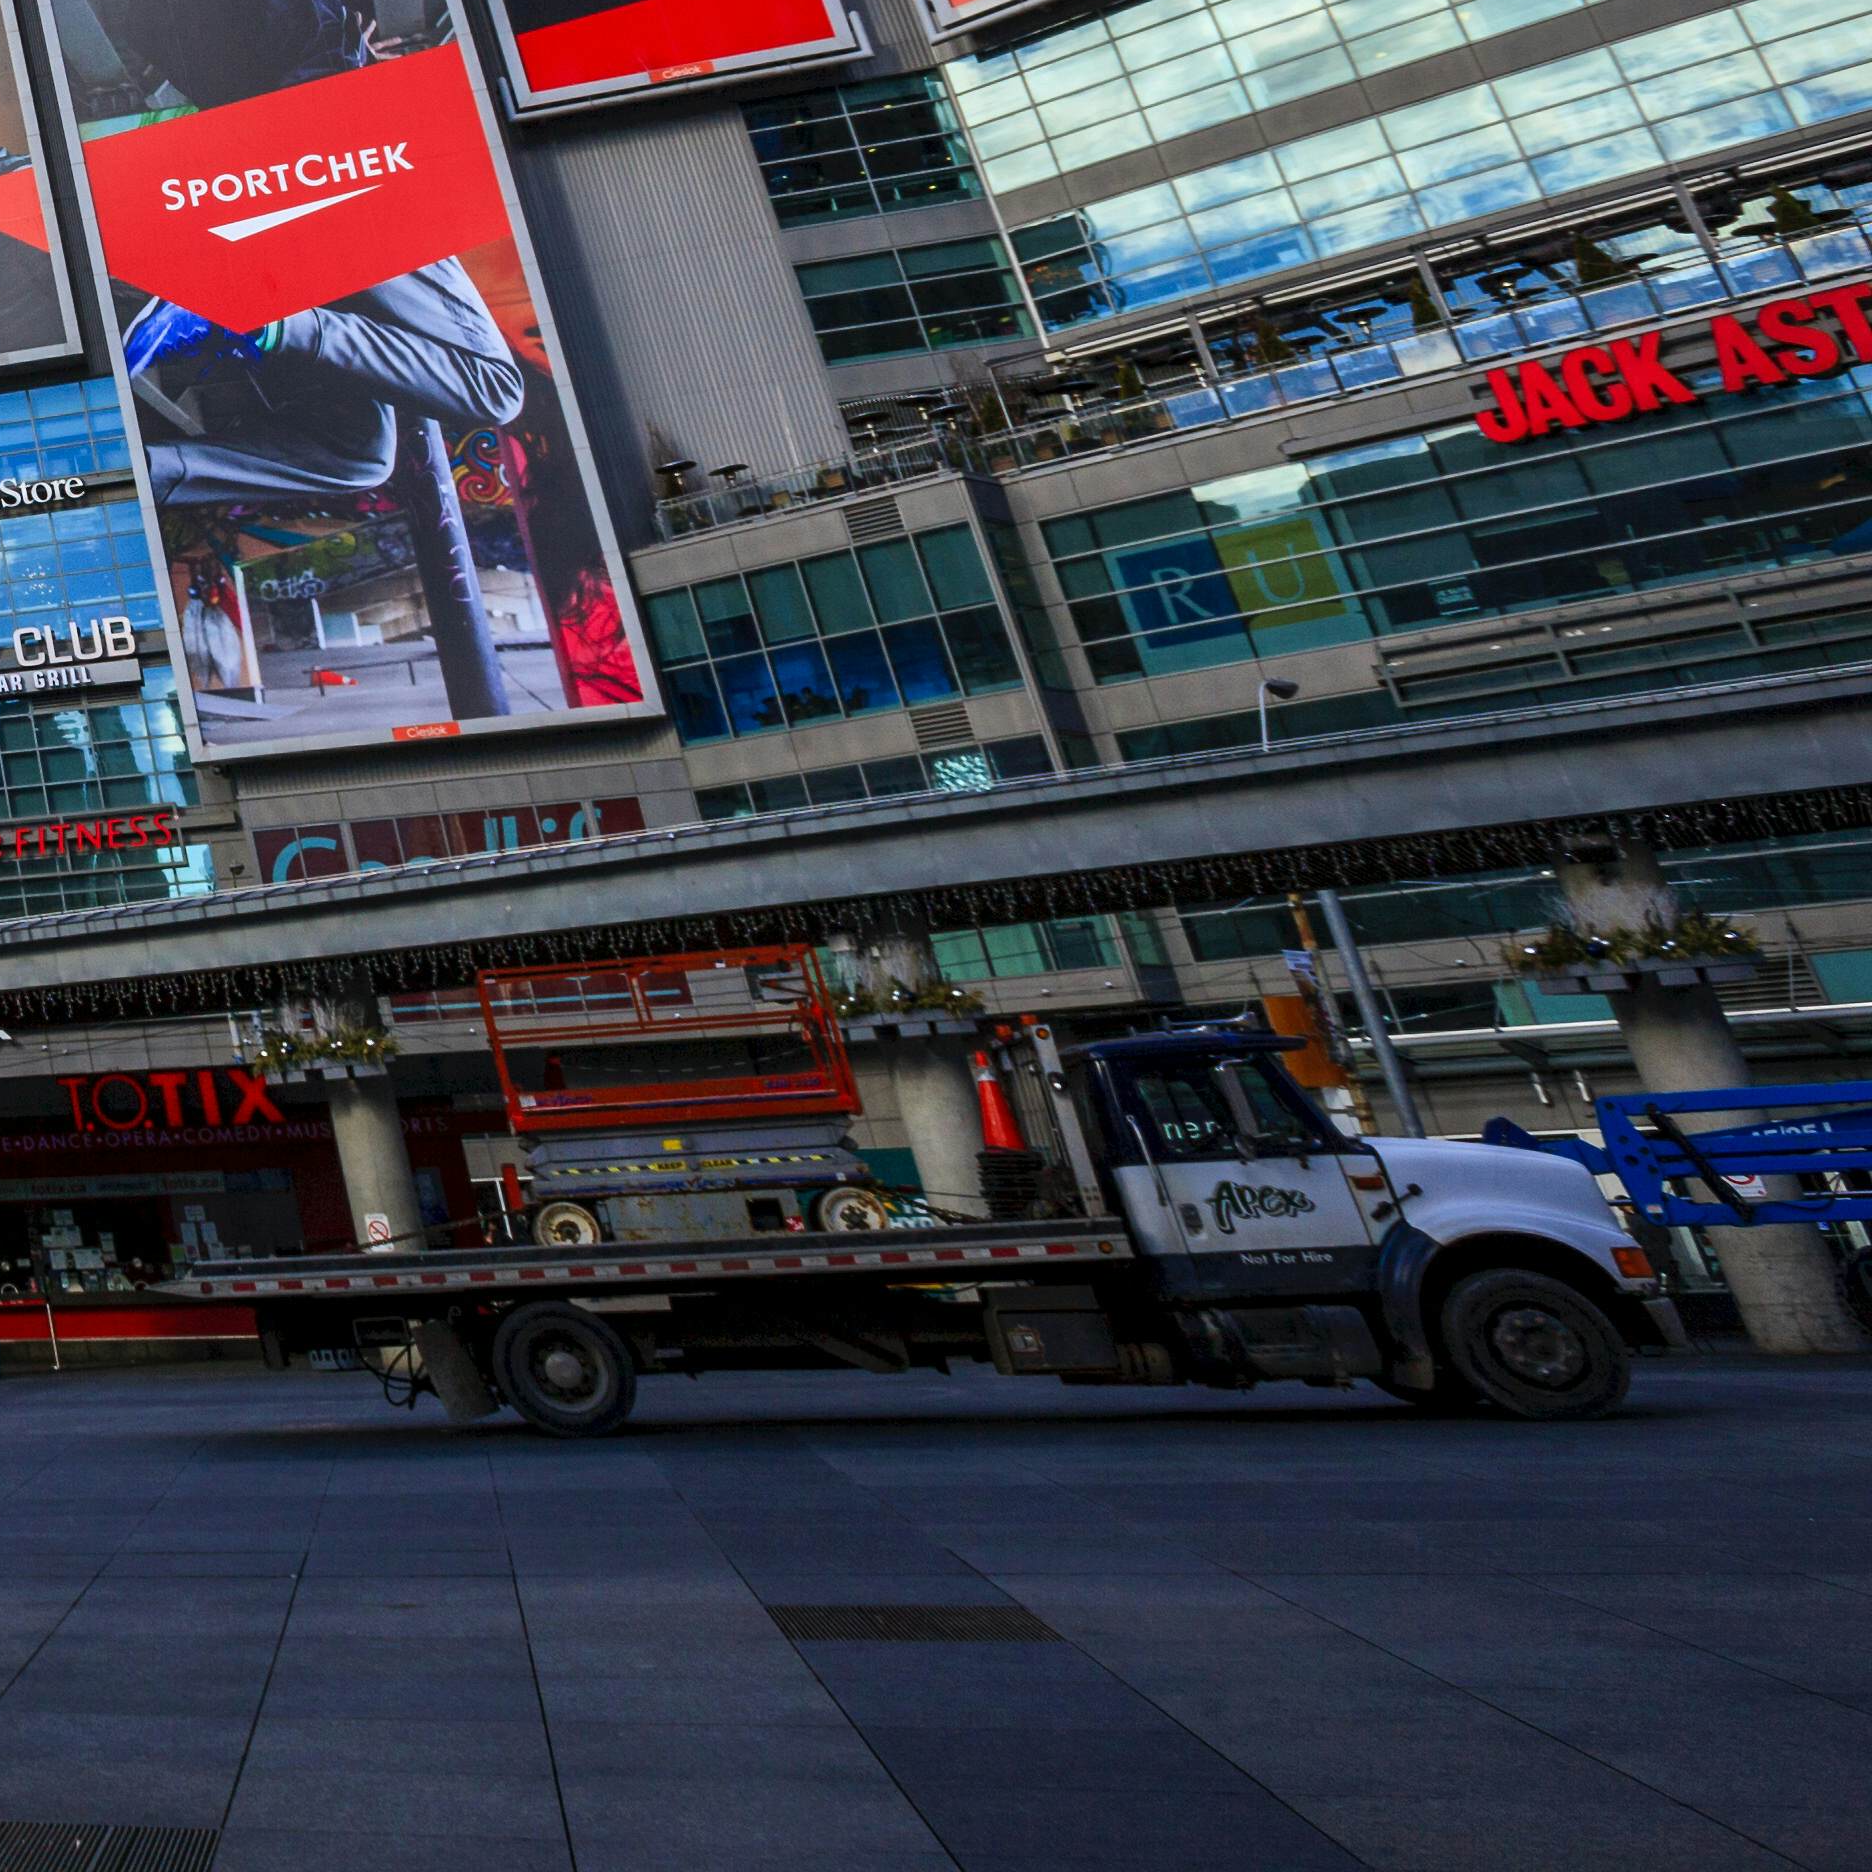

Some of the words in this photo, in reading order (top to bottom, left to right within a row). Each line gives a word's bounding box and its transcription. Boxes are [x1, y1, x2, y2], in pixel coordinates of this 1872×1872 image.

[1475, 330, 1694, 446] JACK
[1711, 284, 1872, 394] AST
[0, 477, 86, 510] Store
[1247, 541, 1307, 604] U
[1150, 569, 1214, 625] R
[12, 615, 137, 666] CLUB
[34, 665, 93, 692] GRILL
[404, 723, 449, 741] Cieslok
[13, 812, 173, 860] FITNESS
[22, 1132, 94, 1151] DANCE
[104, 1130, 172, 1149] OPERA
[182, 1124, 273, 1146] COMEDY
[286, 1121, 331, 1140] MUS
[403, 1116, 447, 1135] ORTS
[658, 1161, 684, 1170] KEEP
[703, 1159, 734, 1168] CLEAR
[1240, 1253, 1268, 1265] Not
[1272, 1252, 1297, 1264] For
[1302, 1250, 1335, 1263] Hire
